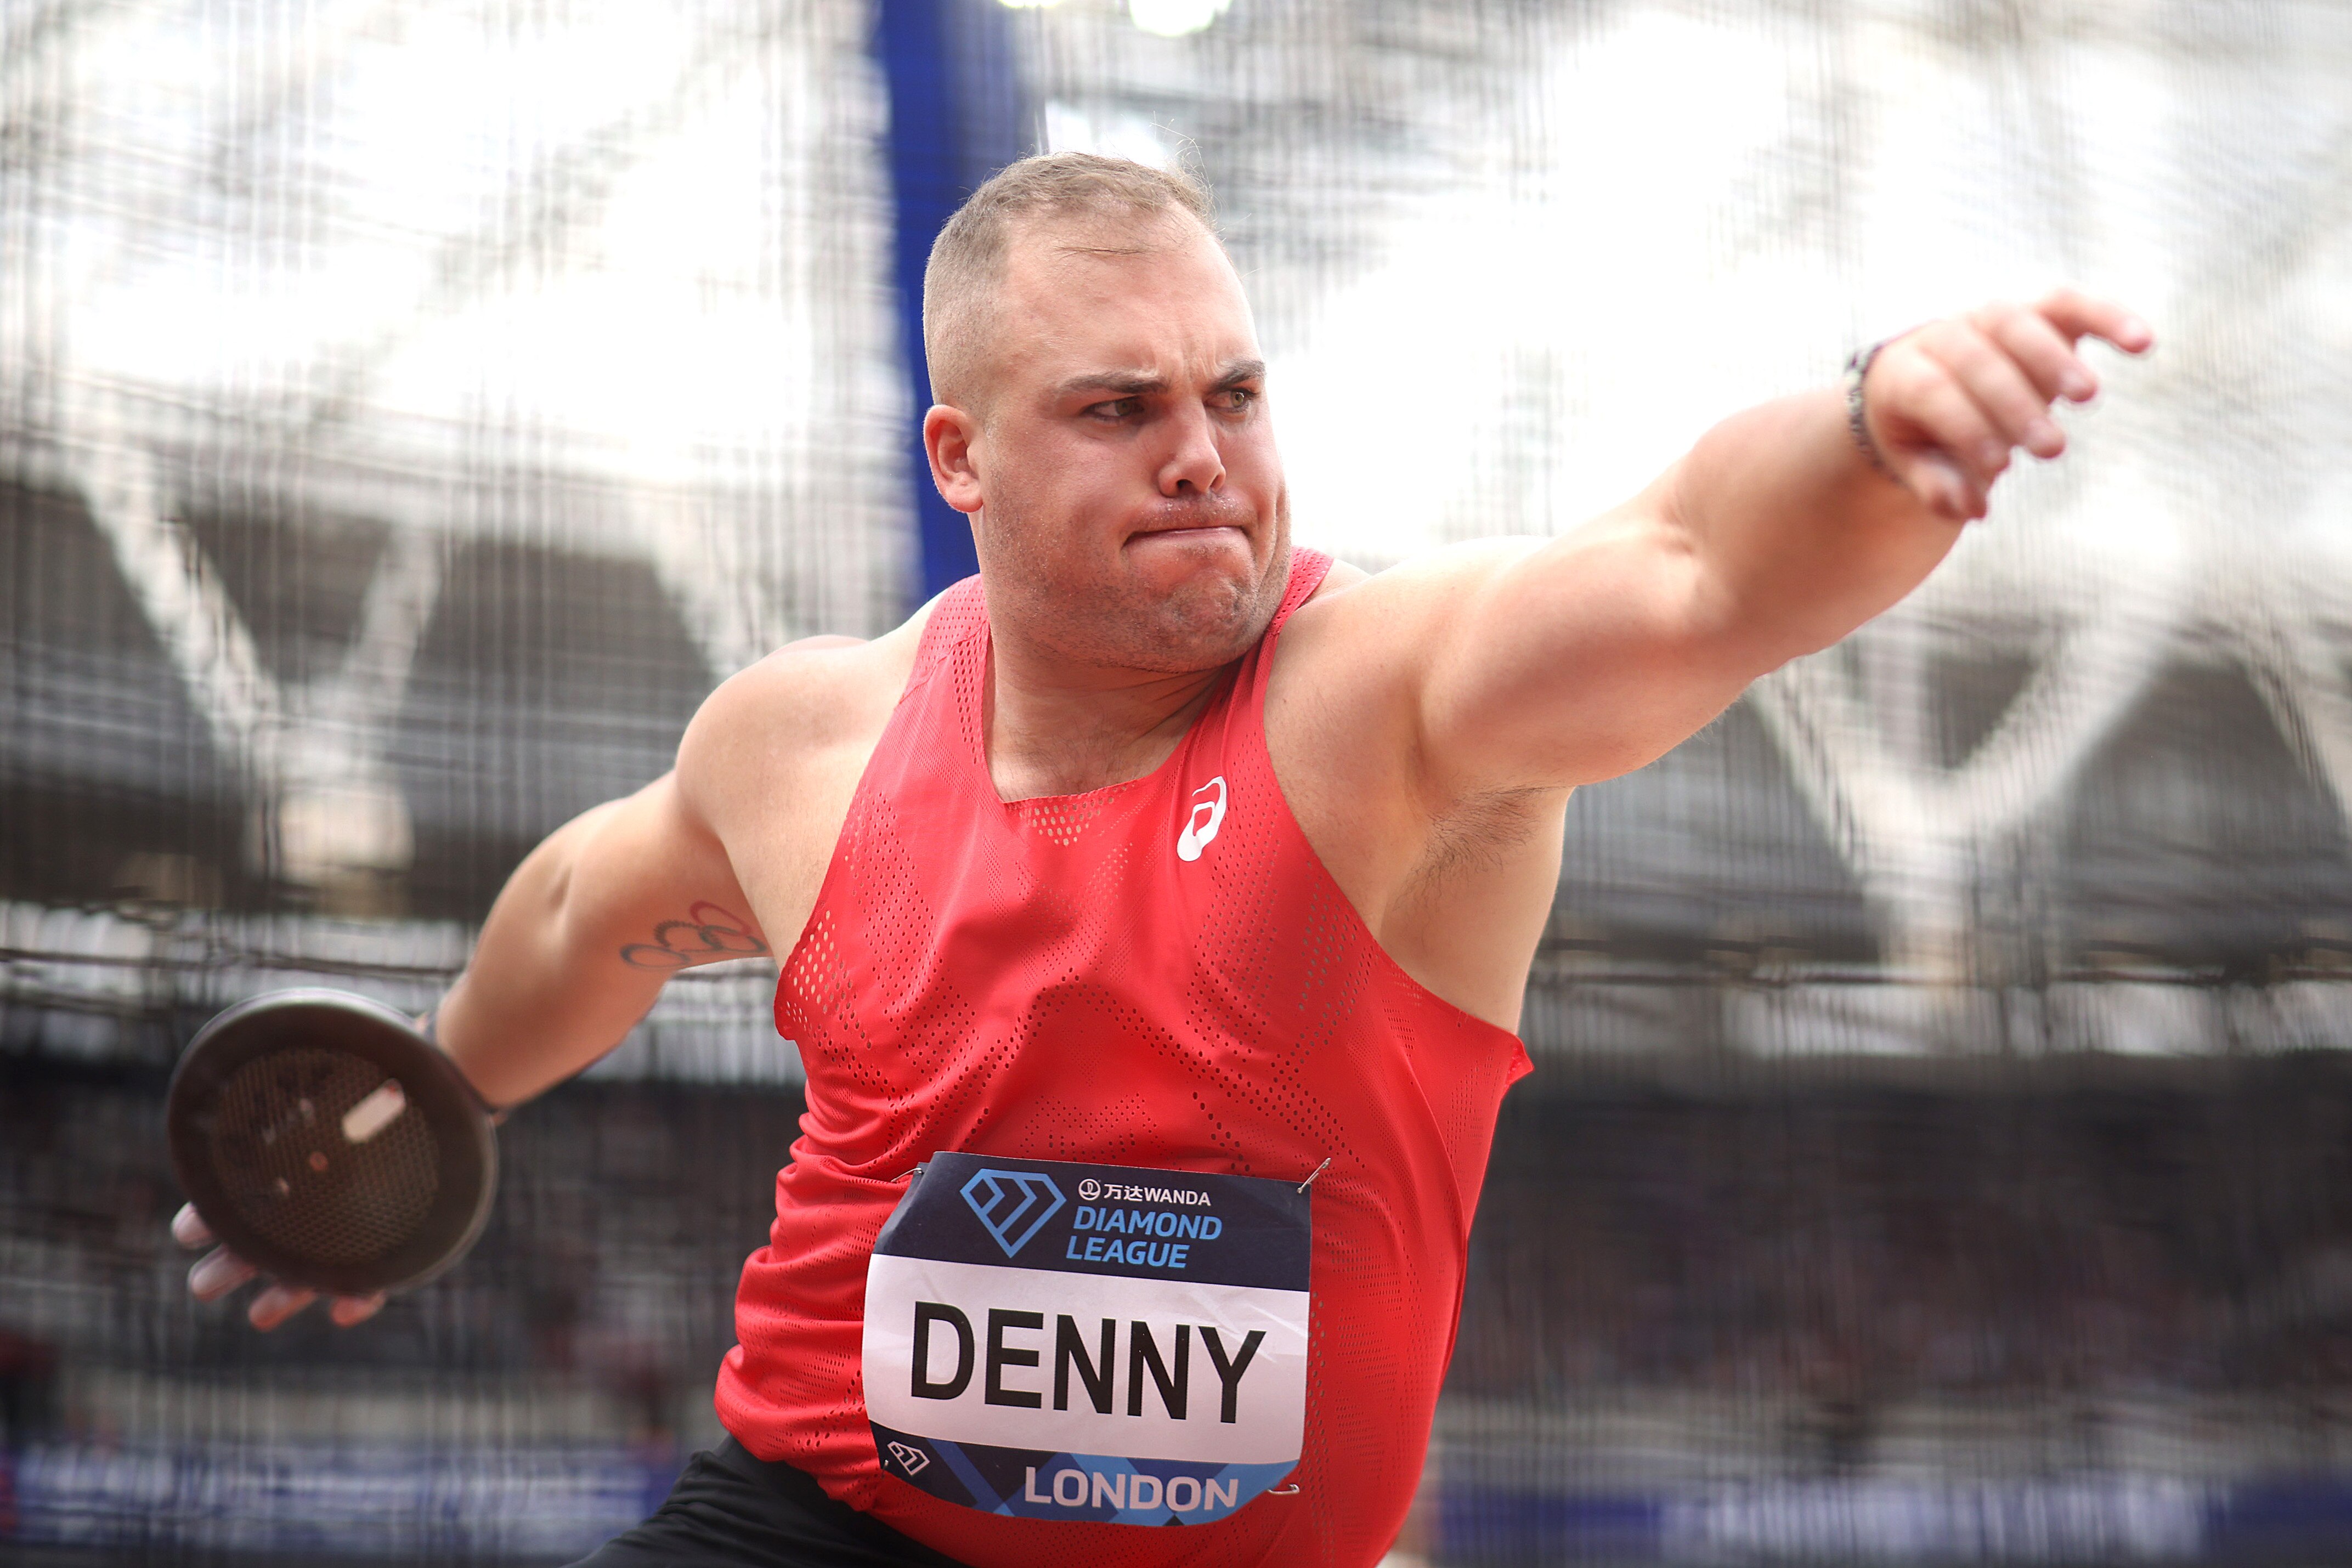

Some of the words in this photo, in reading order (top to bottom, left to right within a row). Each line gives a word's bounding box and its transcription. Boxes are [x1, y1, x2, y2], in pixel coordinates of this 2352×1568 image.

[1073, 1205, 1223, 1240] DIAMOND
[1066, 1235, 1190, 1268] LEAGUE
[911, 1301, 1267, 1424] DENNY
[1025, 1466, 1239, 1512] LONDON
